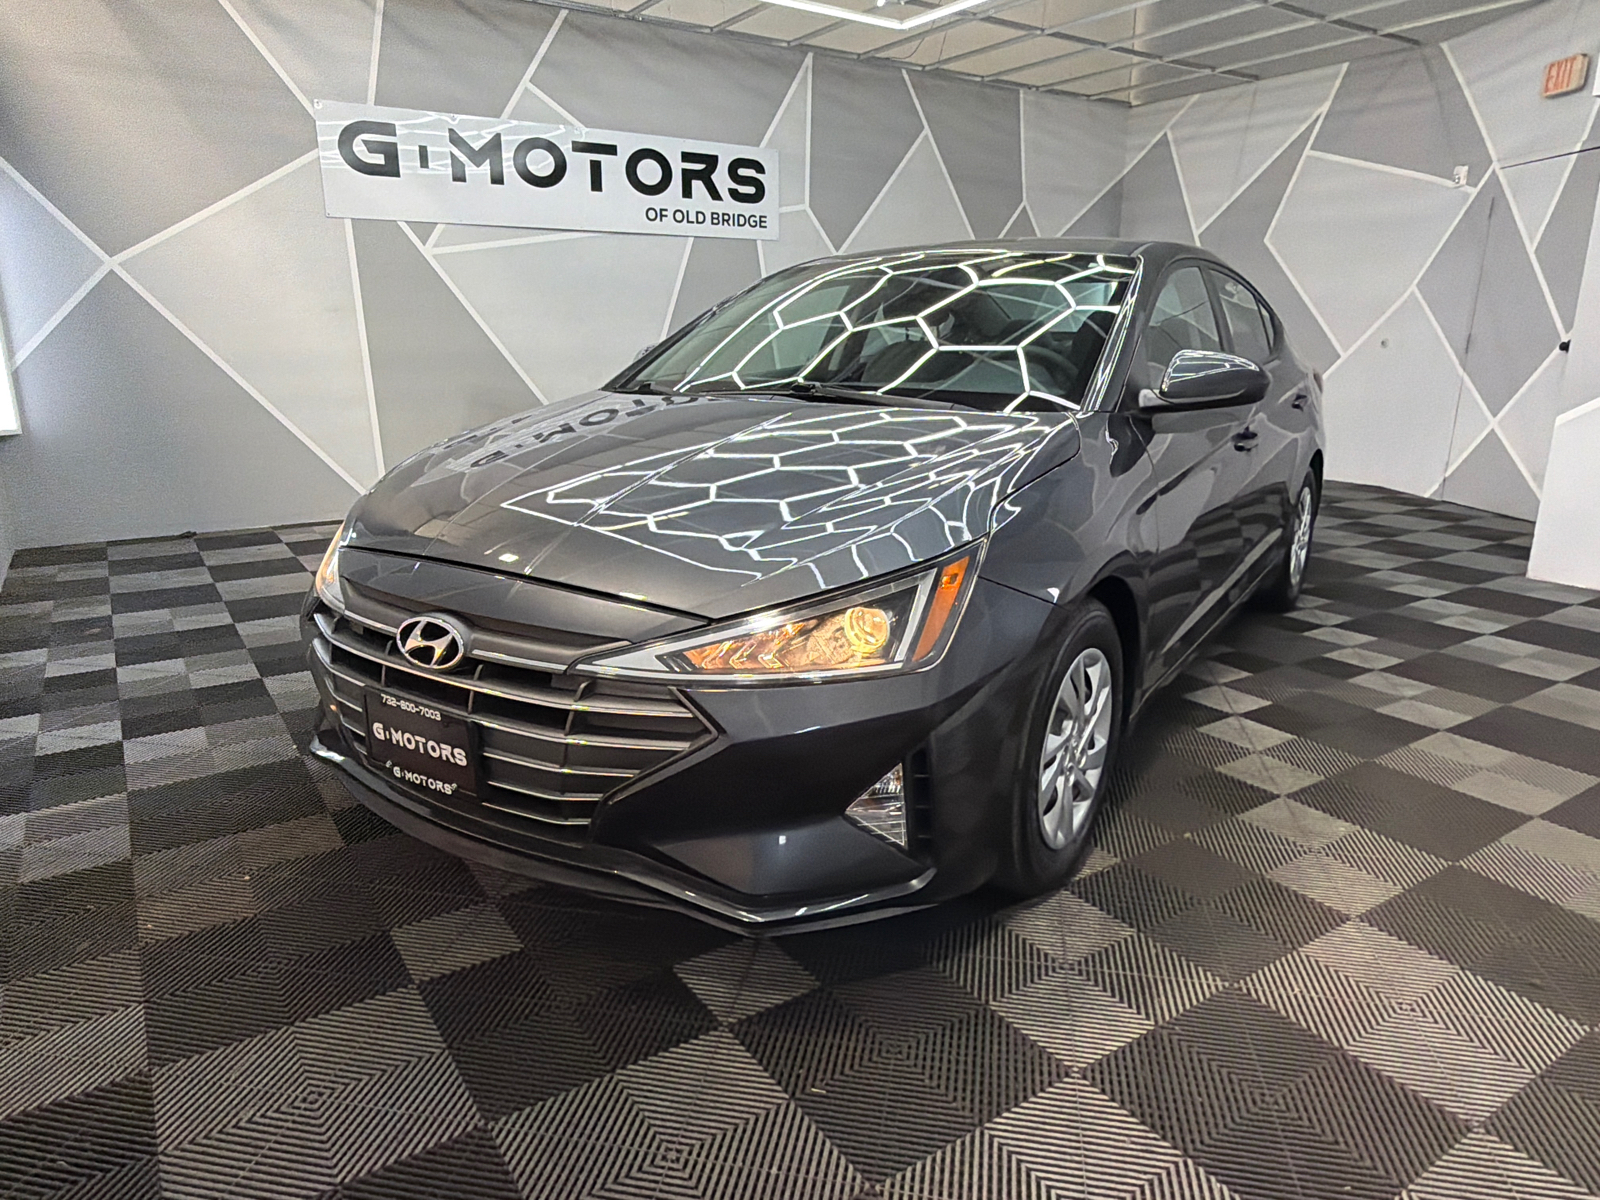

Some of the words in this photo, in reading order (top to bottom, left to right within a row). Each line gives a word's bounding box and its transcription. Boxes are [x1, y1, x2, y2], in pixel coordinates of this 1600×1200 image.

[1544, 56, 1577, 93] EXIT
[645, 207, 669, 222] OF
[672, 209, 706, 226] OLD
[710, 211, 768, 229] BRIDGE
